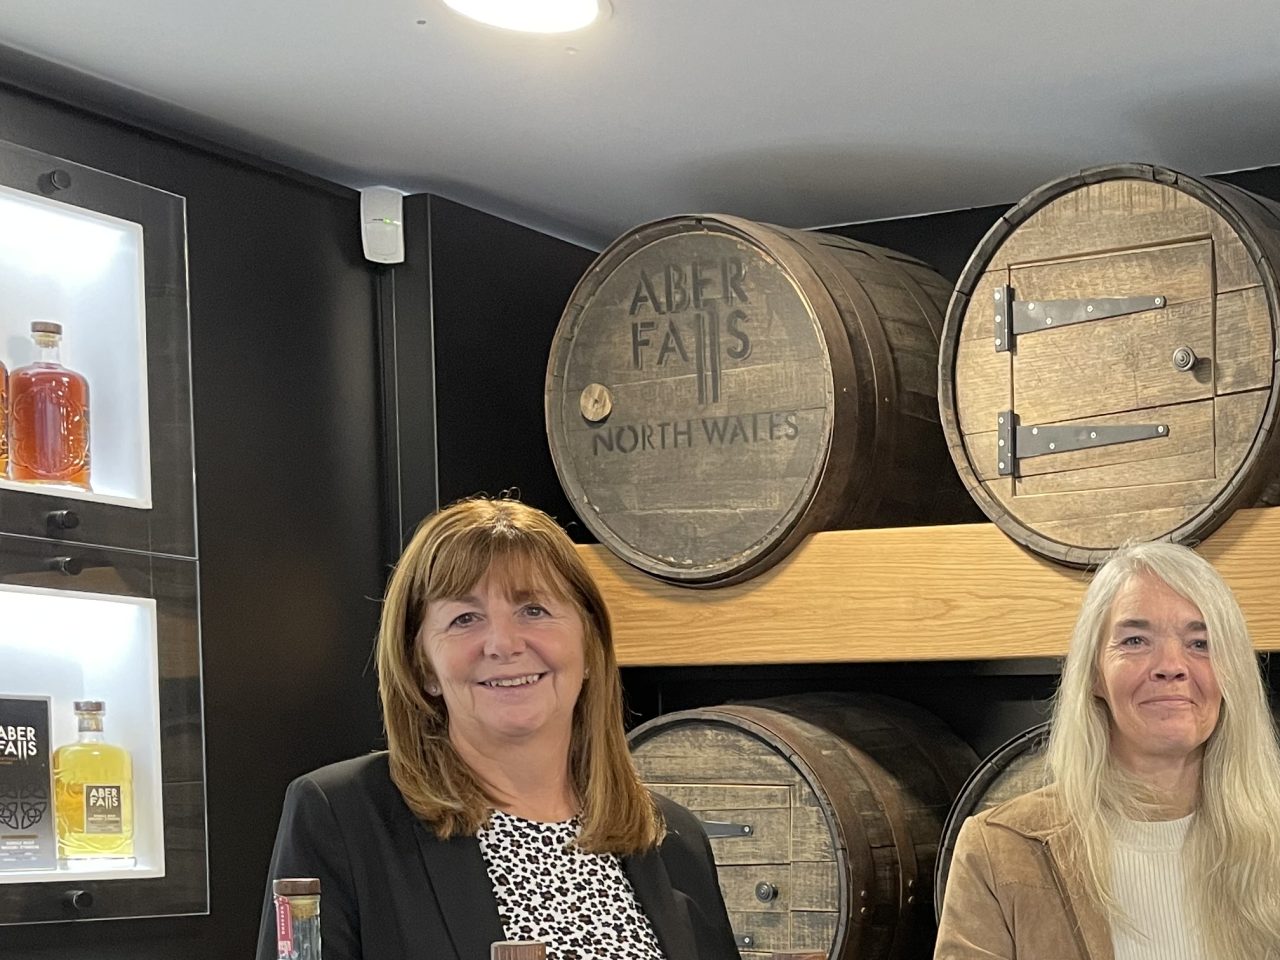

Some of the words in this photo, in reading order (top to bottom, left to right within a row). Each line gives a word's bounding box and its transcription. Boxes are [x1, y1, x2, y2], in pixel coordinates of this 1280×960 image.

[628, 257, 749, 316] ABER
[591, 421, 694, 457] NORTH
[702, 412, 800, 445] WALES
[0, 725, 37, 742] ABER
[90, 788, 118, 798] ABER
